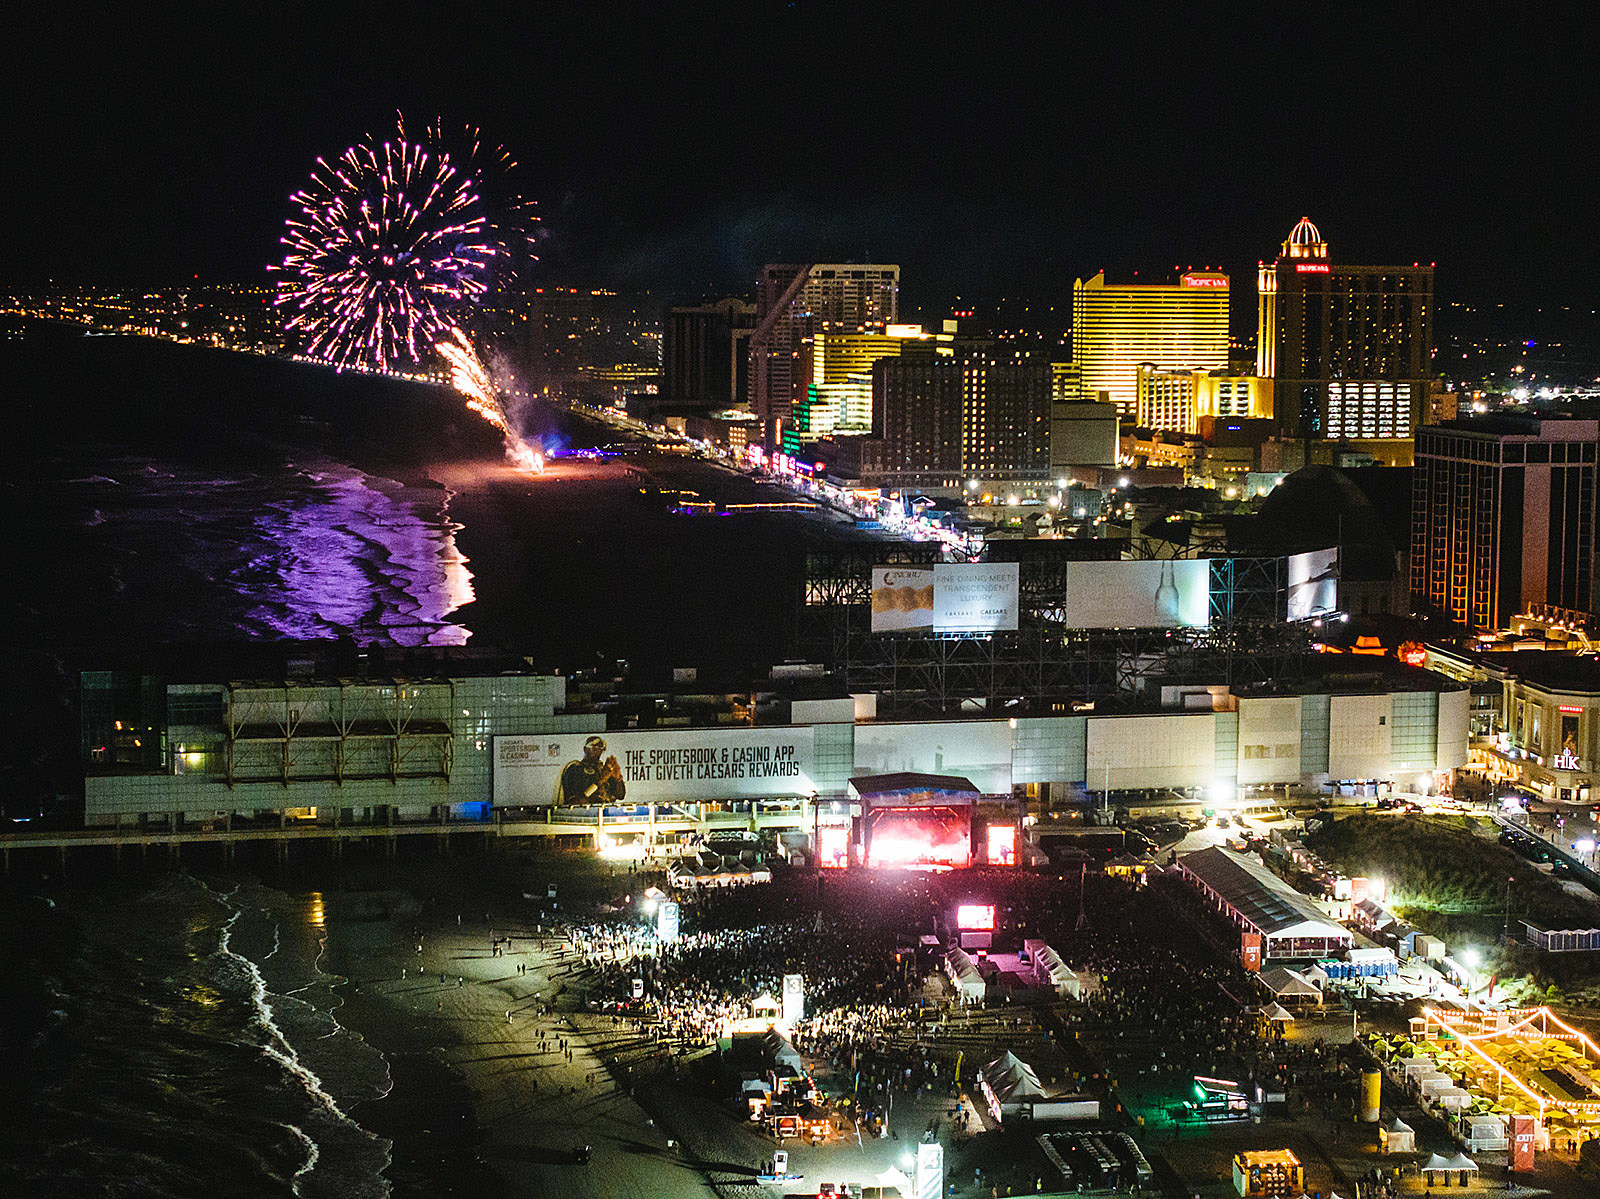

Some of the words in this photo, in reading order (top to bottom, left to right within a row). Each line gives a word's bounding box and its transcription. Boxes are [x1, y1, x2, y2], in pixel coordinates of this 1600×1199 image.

[1296, 264, 1329, 272] TROPICANA
[1185, 276, 1227, 287] TROPICANA
[944, 584, 1011, 592] TRANSCENDENT
[499, 744, 540, 752] SPORTSBOOK
[506, 752, 529, 760] CASINO
[625, 750, 645, 765] THE
[649, 748, 718, 764] SPORTSBOOK
[721, 747, 729, 763] &
[732, 746, 770, 762] CASINO
[774, 745, 795, 761] APP
[625, 765, 651, 781] THAT
[656, 764, 693, 780] GIVETH
[697, 763, 745, 779] CAESARS
[749, 761, 800, 777] REWARDS
[666, 905, 676, 919] 2
[1249, 953, 1256, 962] 3
[789, 979, 800, 993] 3
[1516, 1134, 1535, 1142] EXIT
[1520, 1143, 1529, 1153] 4
